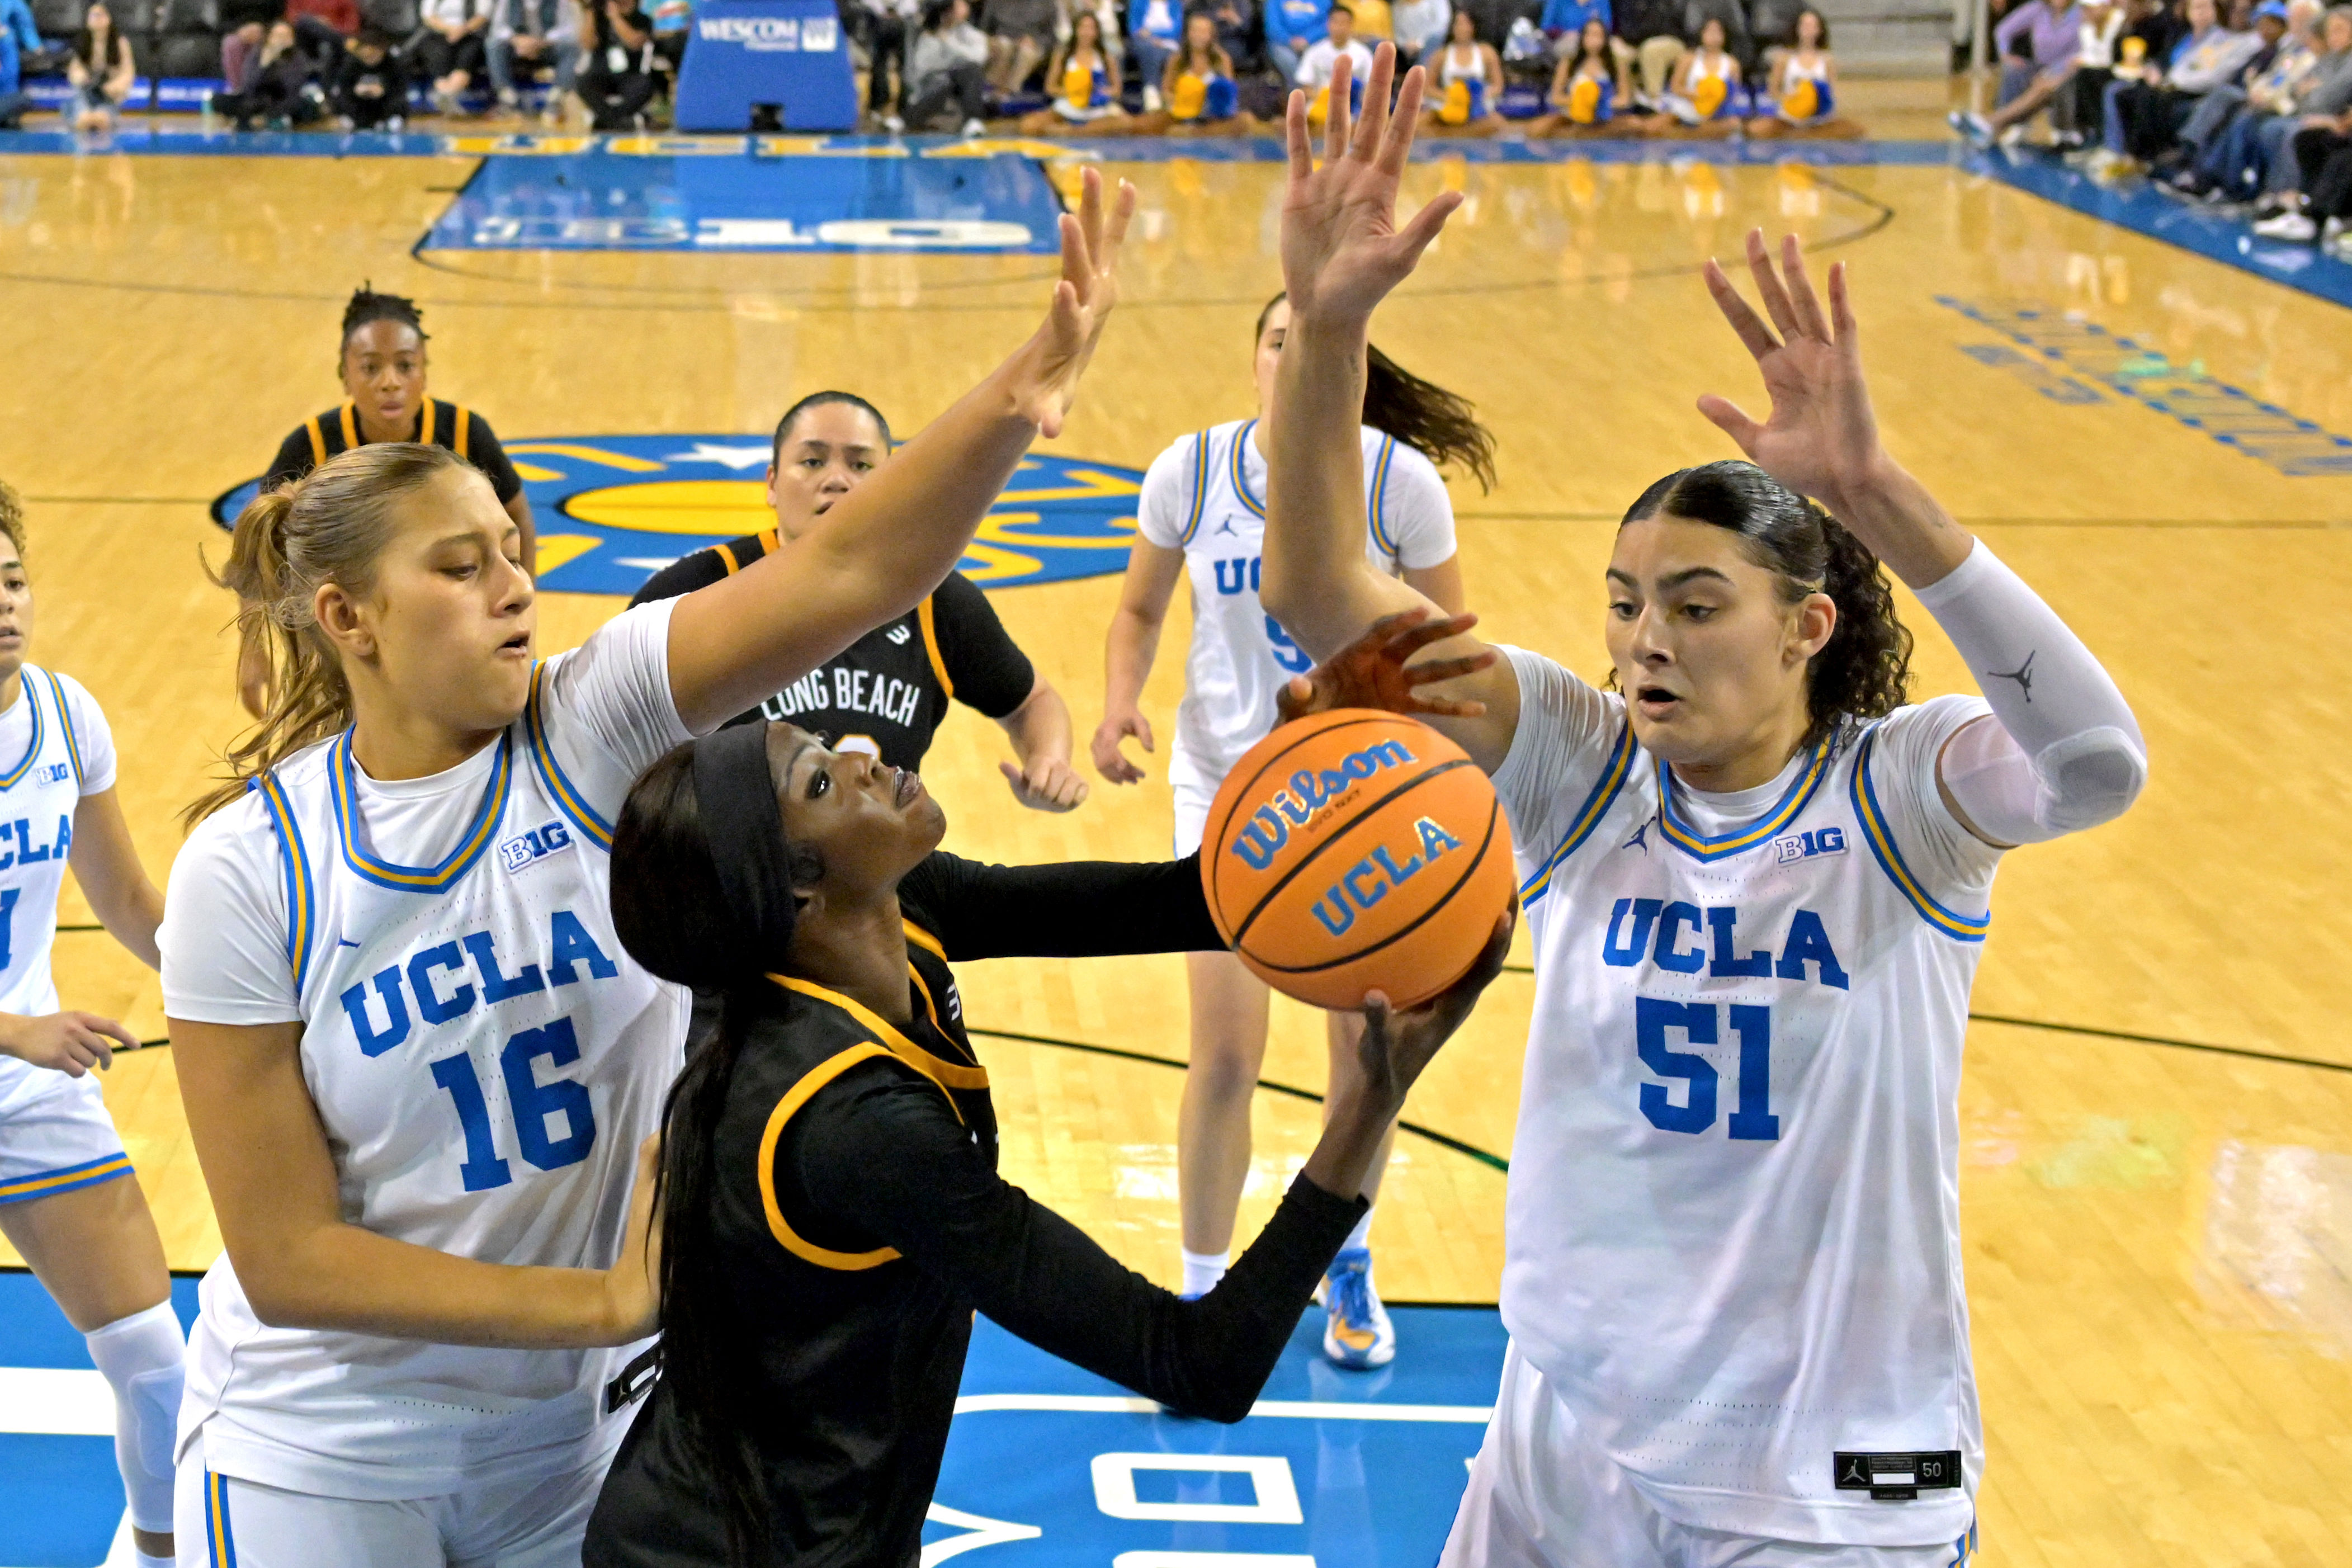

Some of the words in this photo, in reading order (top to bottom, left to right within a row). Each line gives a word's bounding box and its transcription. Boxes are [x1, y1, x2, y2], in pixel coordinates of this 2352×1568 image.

[700, 18, 798, 41] WESCOM
[834, 668, 921, 728] BEACH
[0, 814, 72, 871] CLA
[1231, 738, 1419, 871] Wilson
[1311, 816, 1462, 937] UCLA
[340, 910, 618, 1058] UCLA
[1602, 898, 1849, 991] UCLA
[429, 1016, 597, 1192] 16
[1636, 996, 1779, 1141] 51
[1922, 1462, 1942, 1477] 50
